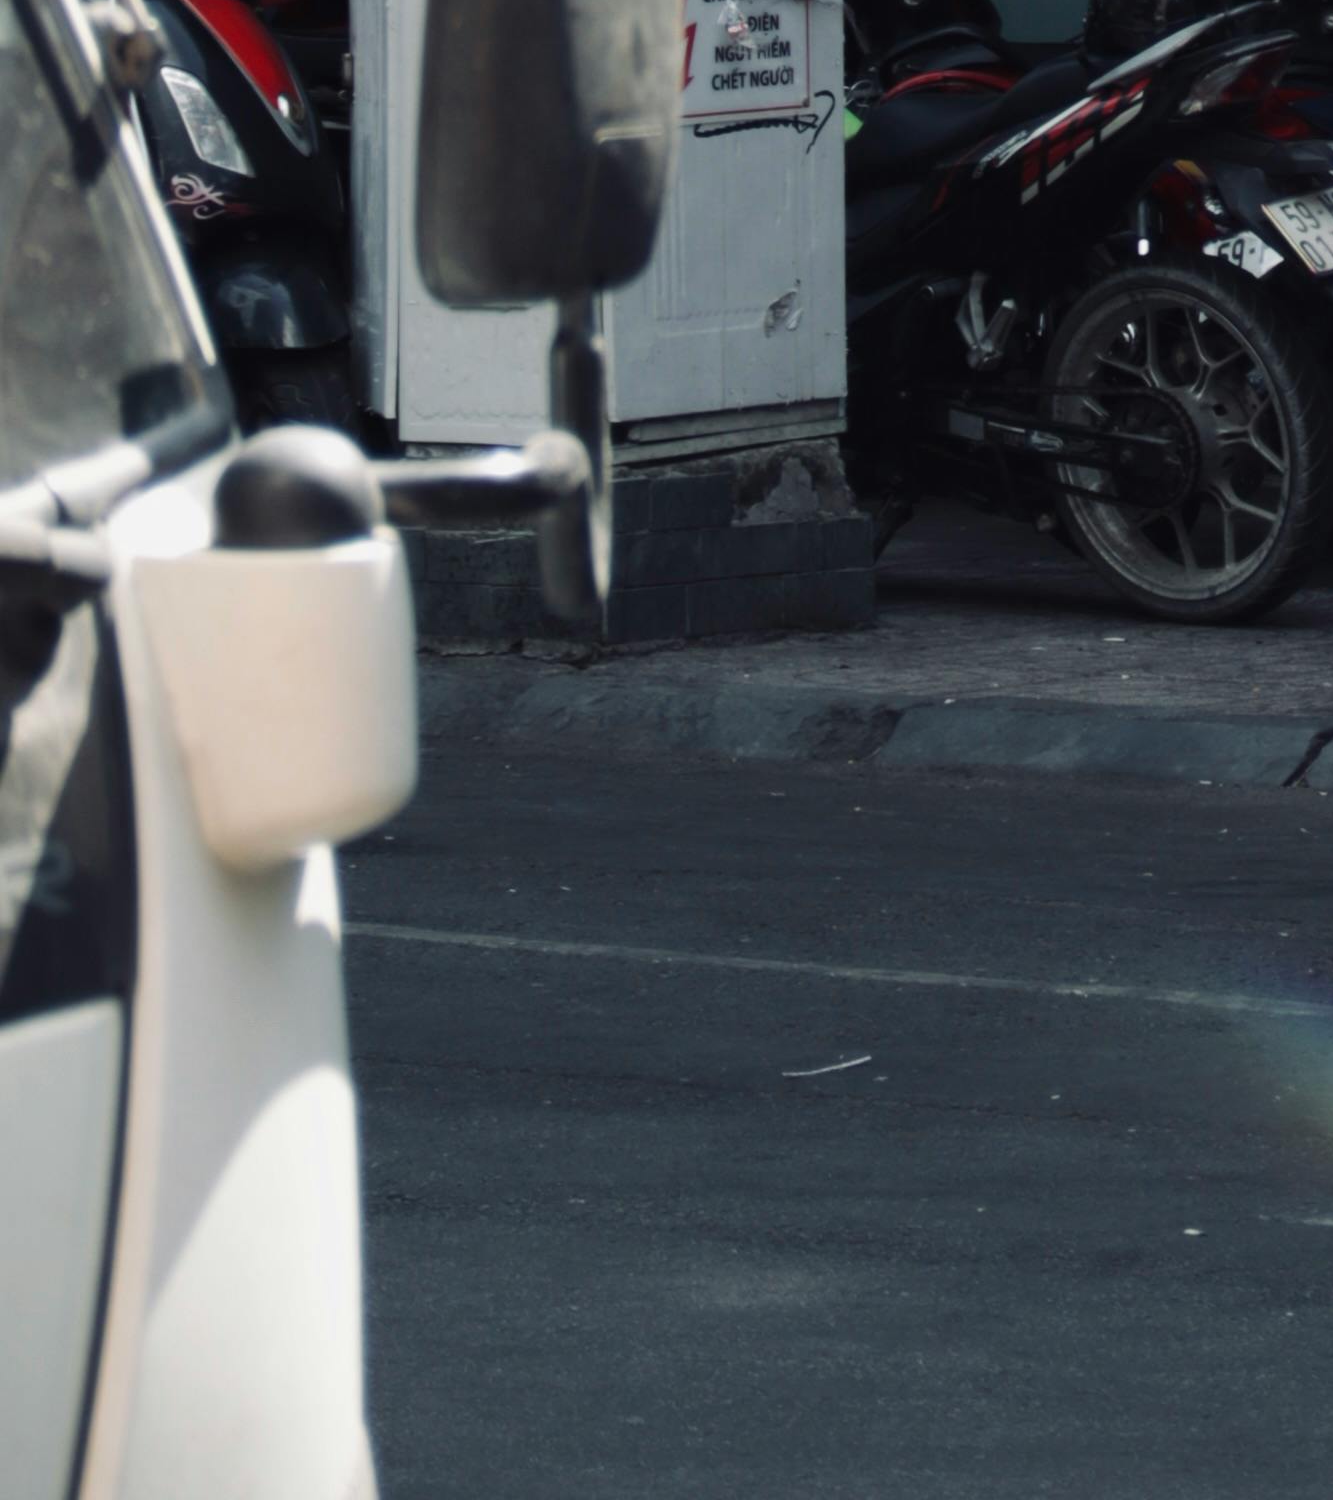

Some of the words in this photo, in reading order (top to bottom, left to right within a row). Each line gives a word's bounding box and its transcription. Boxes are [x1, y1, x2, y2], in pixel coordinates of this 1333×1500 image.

[747, 11, 780, 36] ĐIỆN
[711, 67, 747, 91] CHẾT
[749, 64, 795, 87] NGƯỜI
